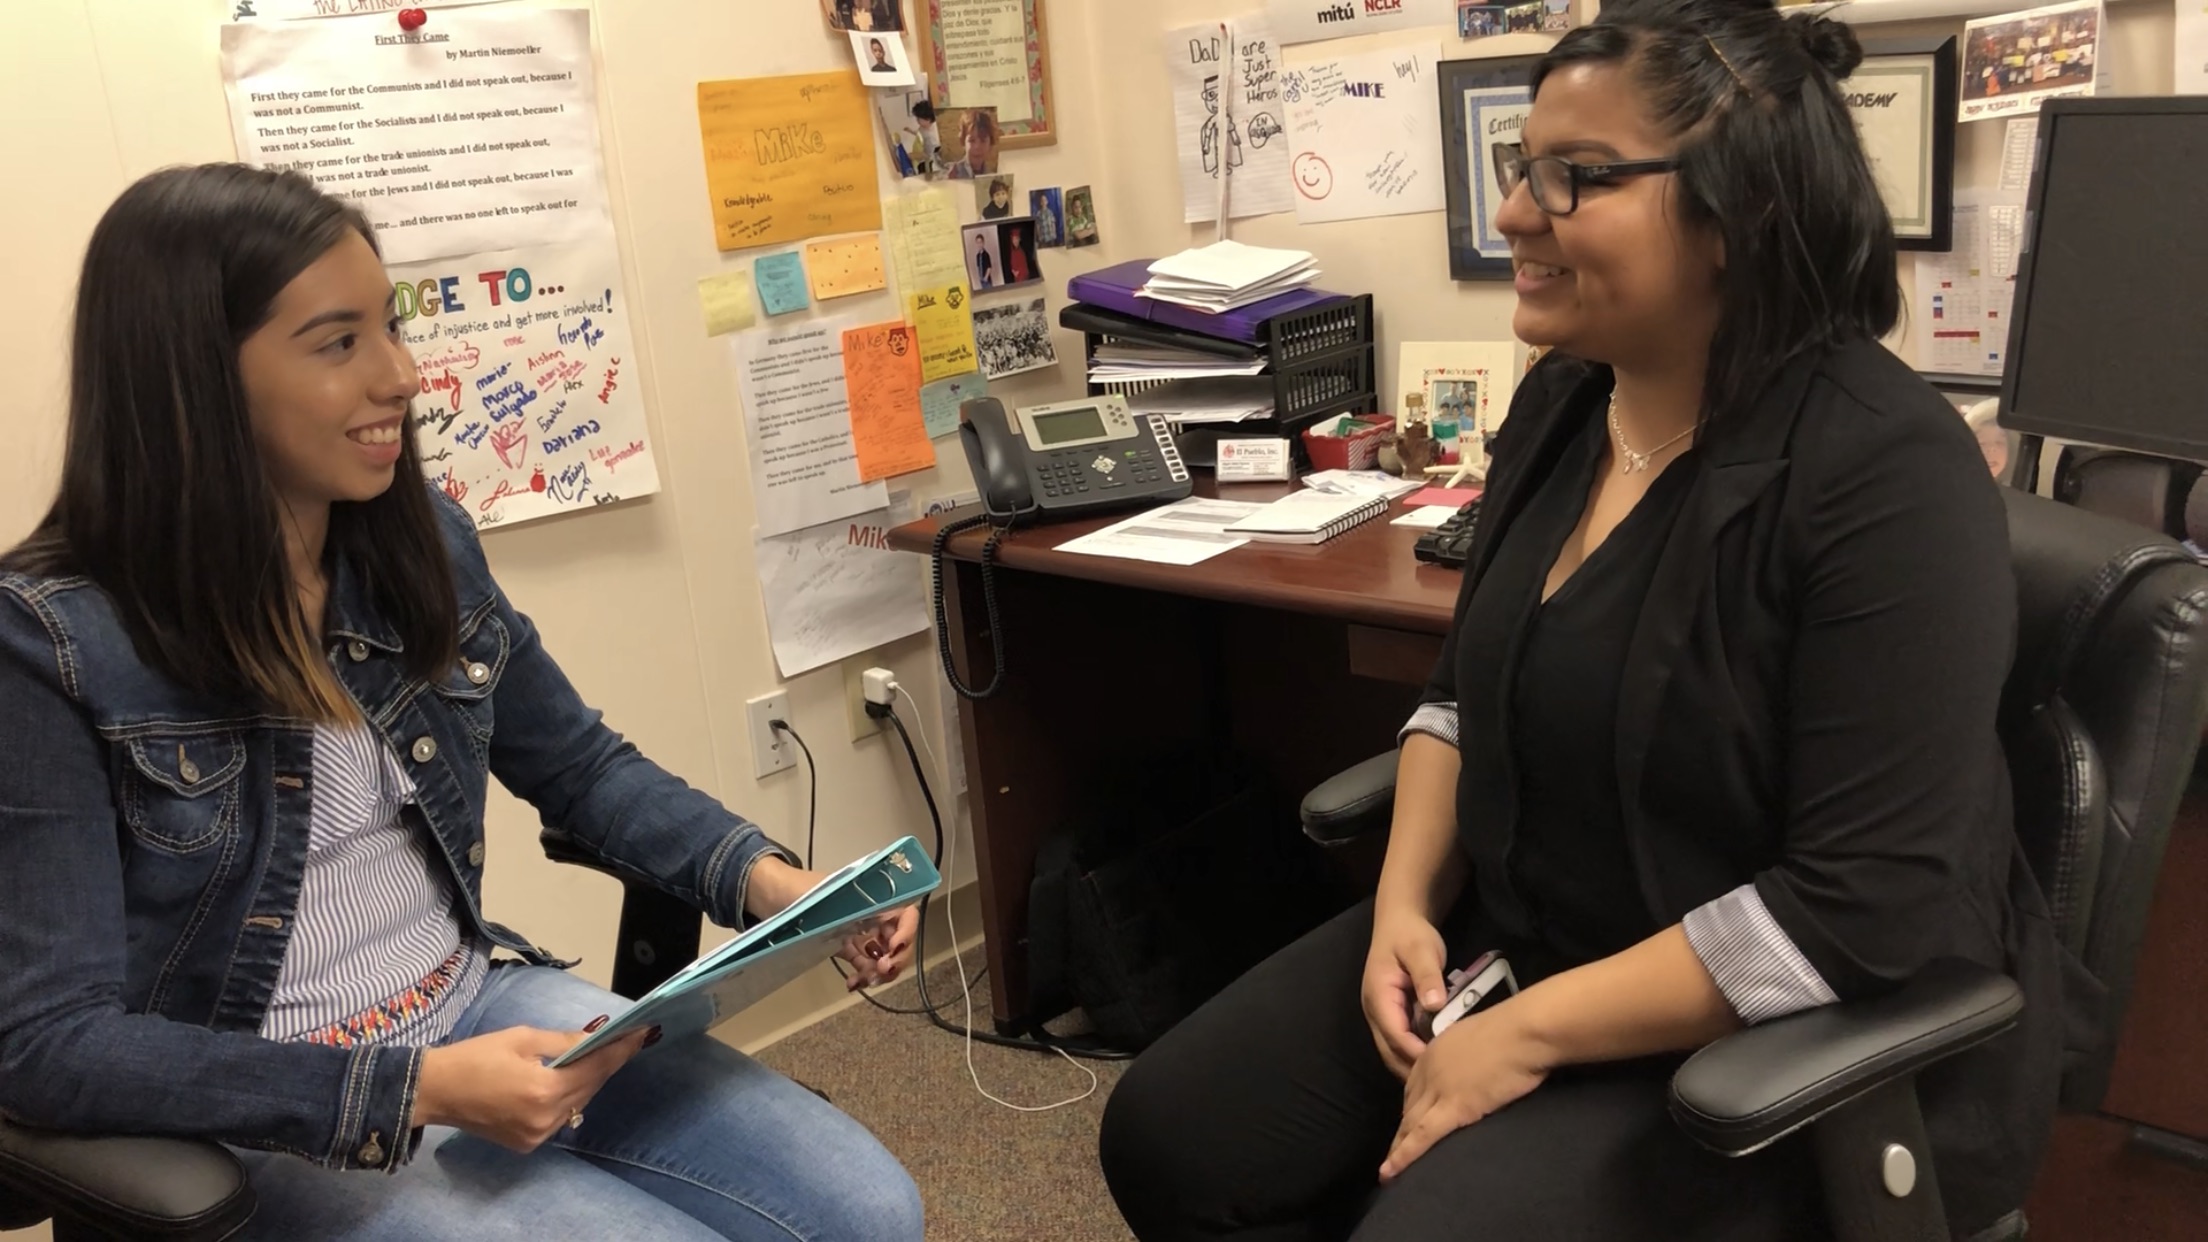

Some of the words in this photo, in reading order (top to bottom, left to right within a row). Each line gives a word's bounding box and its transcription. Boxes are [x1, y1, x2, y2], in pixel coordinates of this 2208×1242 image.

[1317, 2, 1355, 23] mitú
[375, 35, 396, 45] First
[399, 33, 421, 45] They
[423, 33, 450, 43] Came
[1242, 41, 1265, 57] are
[446, 51, 457, 61] by
[460, 50, 490, 59] Martin
[492, 46, 541, 56] Niemoeller
[1243, 54, 1271, 74] Just
[251, 91, 276, 102] First
[277, 90, 300, 102] they
[302, 91, 328, 99] came
[330, 87, 346, 97] for
[348, 85, 364, 95] the
[367, 82, 422, 94] Communists
[424, 81, 440, 90] and
[449, 78, 464, 88] did
[466, 78, 481, 87] not
[483, 74, 509, 87] speak
[530, 72, 566, 82] because
[1244, 70, 1276, 91] Super
[1344, 82, 1385, 98] MIKE
[1247, 88, 1278, 104] Heros
[1844, 91, 1898, 108] ADEMY
[253, 110, 274, 118] was
[276, 107, 293, 116] not
[257, 128, 284, 137] Then
[286, 125, 308, 136] they
[310, 124, 337, 133] came
[339, 121, 354, 130] for
[356, 119, 373, 129] the
[375, 116, 417, 128] Socialists
[418, 114, 435, 124] and
[443, 112, 458, 122] did
[459, 111, 475, 120] not
[476, 108, 503, 121] speak
[522, 105, 558, 115] because
[1488, 113, 1528, 135] Certific
[261, 145, 281, 153] was
[283, 142, 300, 150] not
[292, 159, 314, 170] they
[316, 159, 344, 168] came
[346, 156, 361, 165] for
[363, 154, 380, 163] the
[381, 151, 404, 161] trade
[406, 148, 447, 159] unionists
[448, 146, 466, 155] and
[473, 143, 487, 153] did
[488, 142, 504, 151] not
[505, 139, 532, 151] speak
[316, 174, 336, 183] was
[338, 172, 355, 181] not
[365, 168, 389, 178] trade
[352, 188, 367, 198] for
[369, 187, 385, 196] the
[387, 185, 409, 196] Jews
[411, 183, 428, 192] and
[435, 180, 450, 190] did
[451, 179, 466, 188] not
[468, 176, 494, 188] speak
[513, 171, 549, 181] because
[556, 168, 573, 176] was
[399, 216, 417, 227] and
[420, 215, 444, 225] there
[445, 213, 463, 222] was
[465, 212, 476, 220] no
[478, 210, 494, 218] one
[495, 207, 509, 216] left
[510, 206, 519, 214] to
[521, 203, 546, 215] speak
[548, 201, 562, 209] out
[564, 199, 578, 208] for
[402, 330, 426, 344] face
[429, 322, 441, 340] of
[444, 322, 490, 339] injustice
[493, 314, 512, 329] and
[515, 313, 532, 330] get
[535, 310, 560, 322] more
[542, 419, 601, 455] Dariana
[848, 524, 887, 550] Mik
